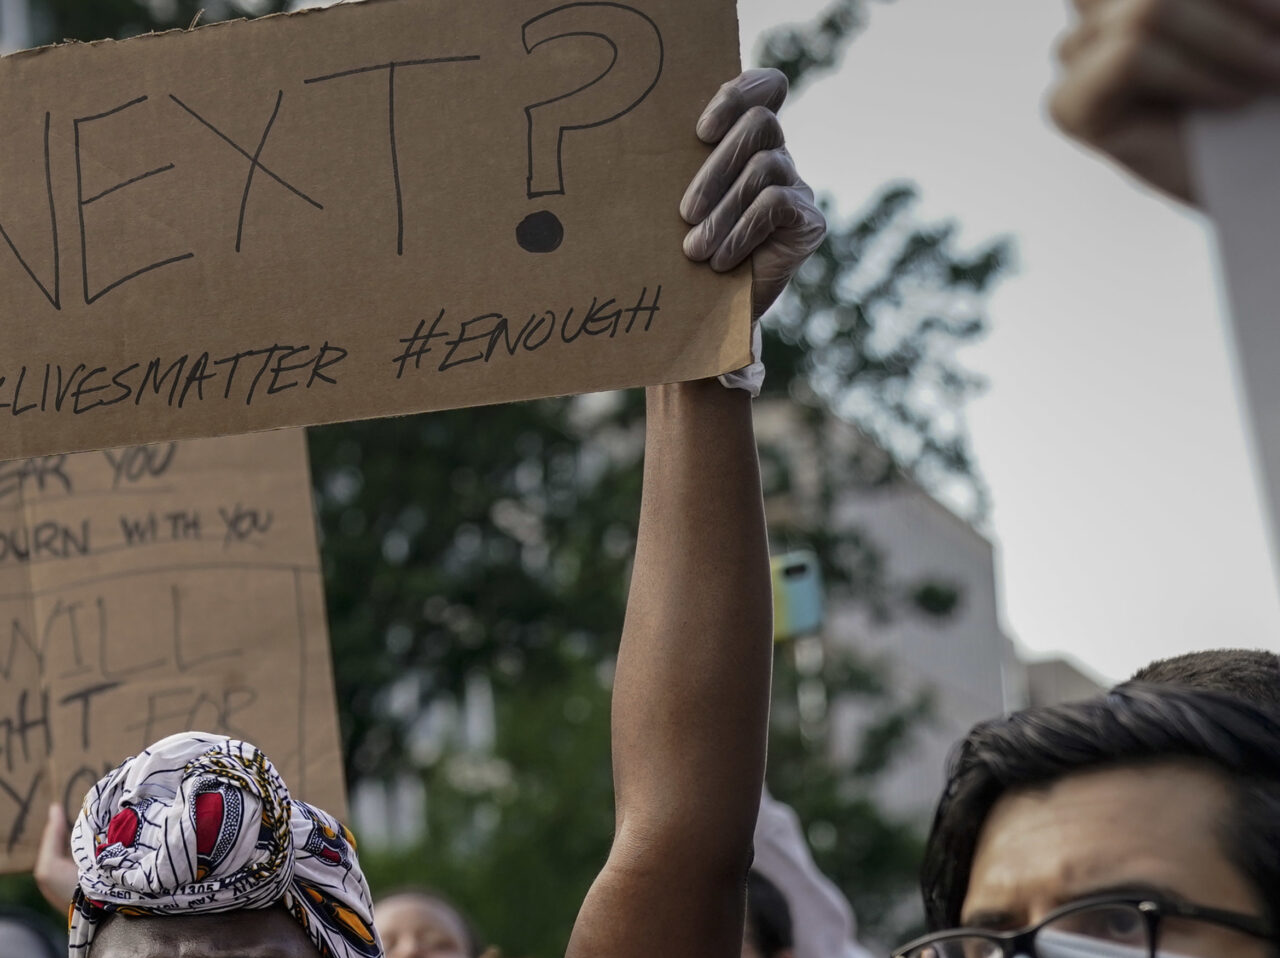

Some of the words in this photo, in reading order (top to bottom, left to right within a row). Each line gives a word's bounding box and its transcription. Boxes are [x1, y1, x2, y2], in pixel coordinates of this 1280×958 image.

[393, 285, 662, 379] #ENOUGH
[104, 441, 177, 490] YOU
[121, 510, 202, 545] WITH
[219, 503, 274, 548] YOU
